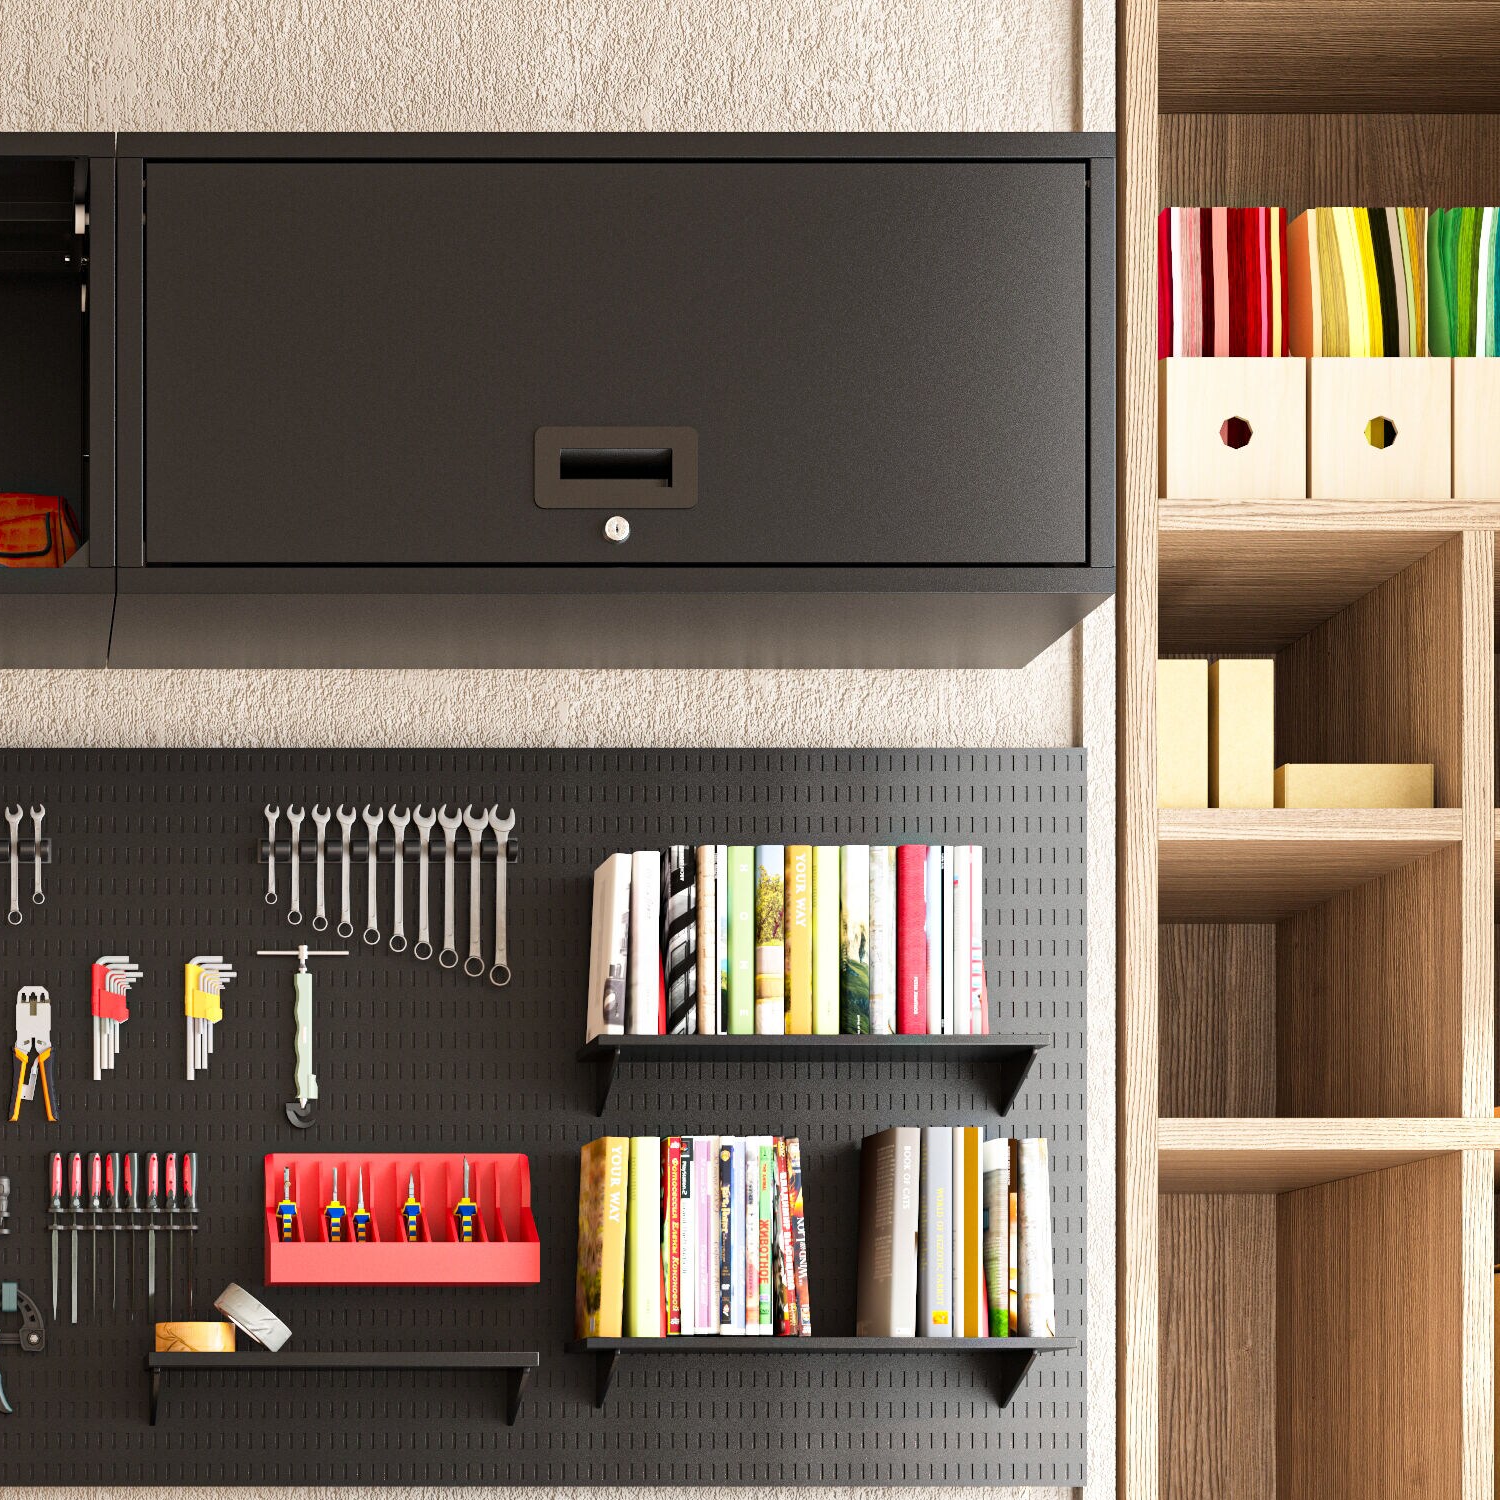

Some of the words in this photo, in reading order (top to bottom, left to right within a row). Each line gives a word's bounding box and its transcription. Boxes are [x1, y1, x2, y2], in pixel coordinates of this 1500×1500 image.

[796, 853, 807, 894] YOUR
[796, 897, 807, 927] WAY
[610, 1145, 623, 1188] YOUR
[903, 1145, 911, 1170] BOOK
[903, 1174, 911, 1185] OF
[608, 1191, 620, 1223] WAY
[902, 1188, 911, 1210] CATS
[936, 1188, 944, 1216] WORLD
[936, 1221, 944, 1231] OF
[759, 1220, 769, 1284] ЖИВОТНОЕ
